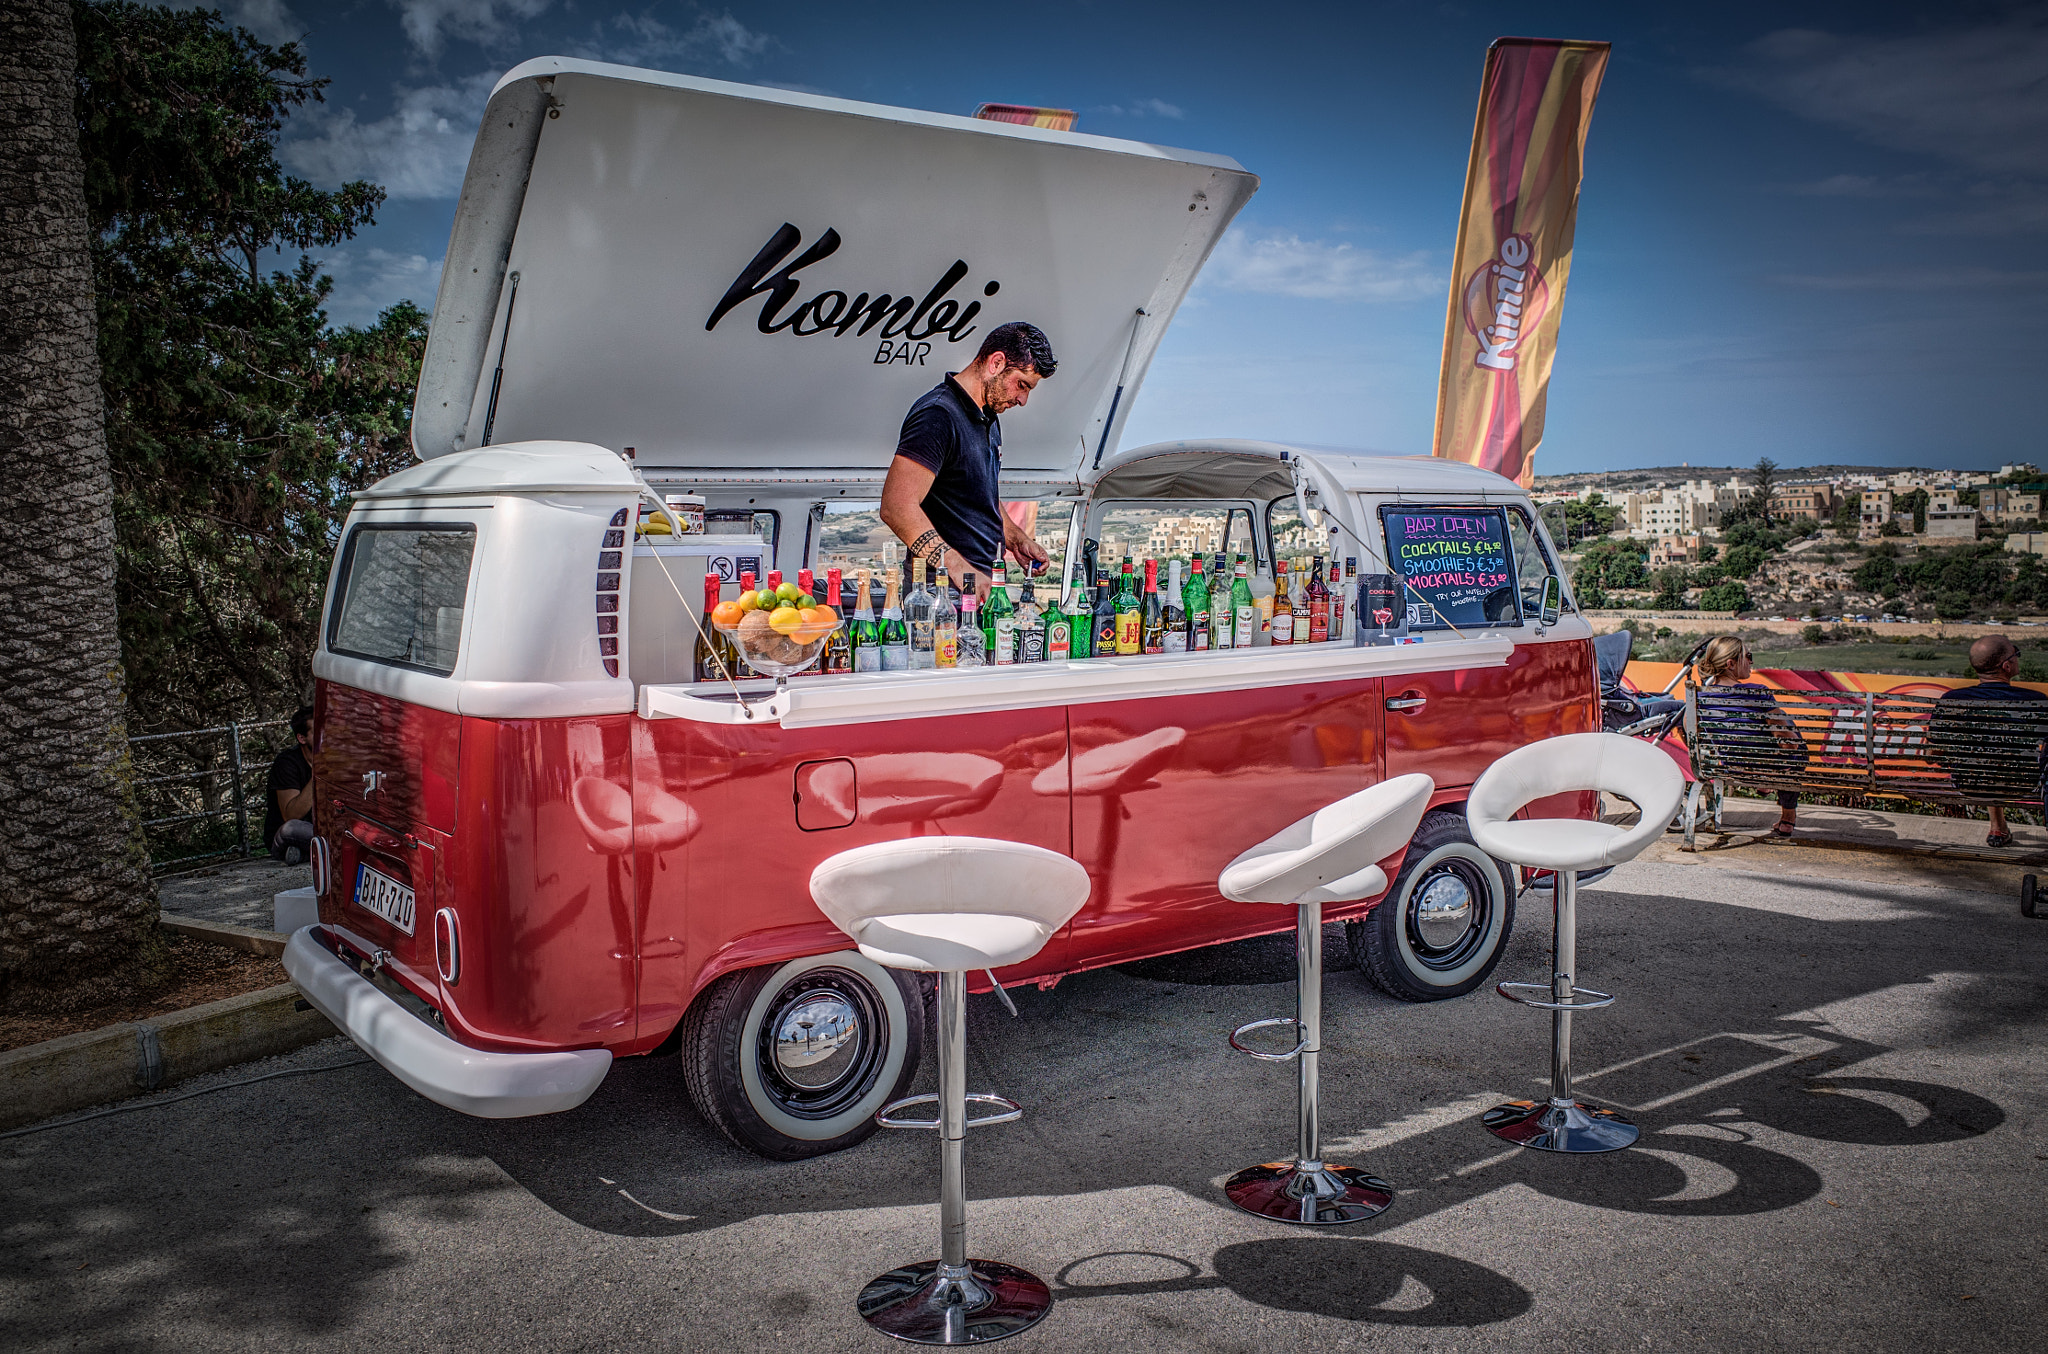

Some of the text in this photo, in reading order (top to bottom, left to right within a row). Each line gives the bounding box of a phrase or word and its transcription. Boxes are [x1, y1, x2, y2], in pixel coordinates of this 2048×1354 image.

[705, 222, 1000, 342] Kombi
[1475, 234, 1532, 372] Kinnie
[873, 340, 931, 366] BAR
[1404, 517, 1487, 534] BAR OPEN
[1400, 541, 1472, 558] COCKTAILS
[1404, 557, 1475, 575] SMOOTHIES
[1408, 572, 1476, 589] MOCKTAILS
[1435, 588, 1491, 601] TRY OUR NUTELLA
